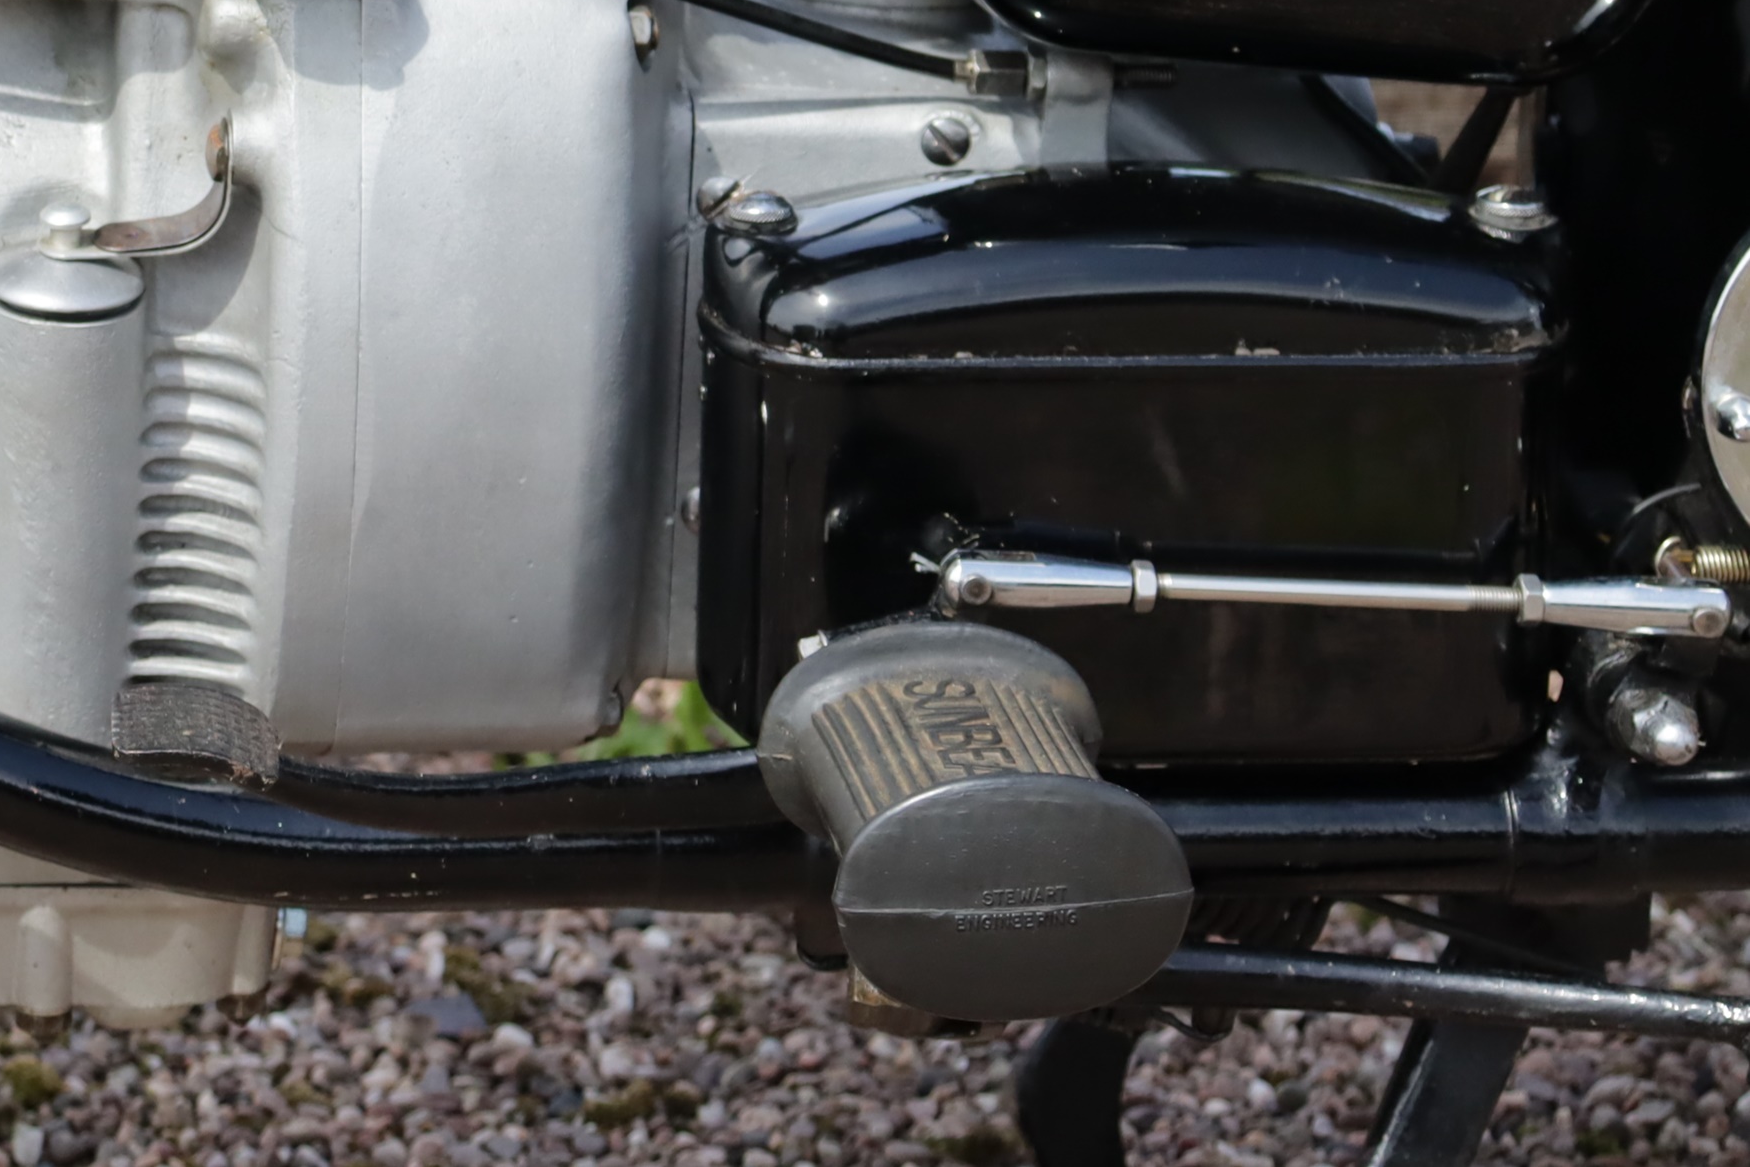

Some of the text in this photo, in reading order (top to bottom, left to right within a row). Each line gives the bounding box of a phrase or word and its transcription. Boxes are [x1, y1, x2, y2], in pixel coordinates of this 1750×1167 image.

[902, 678, 1021, 777] SUNBEA
[981, 884, 1068, 906] STEWART
[954, 908, 1078, 932] ENGINEERING
